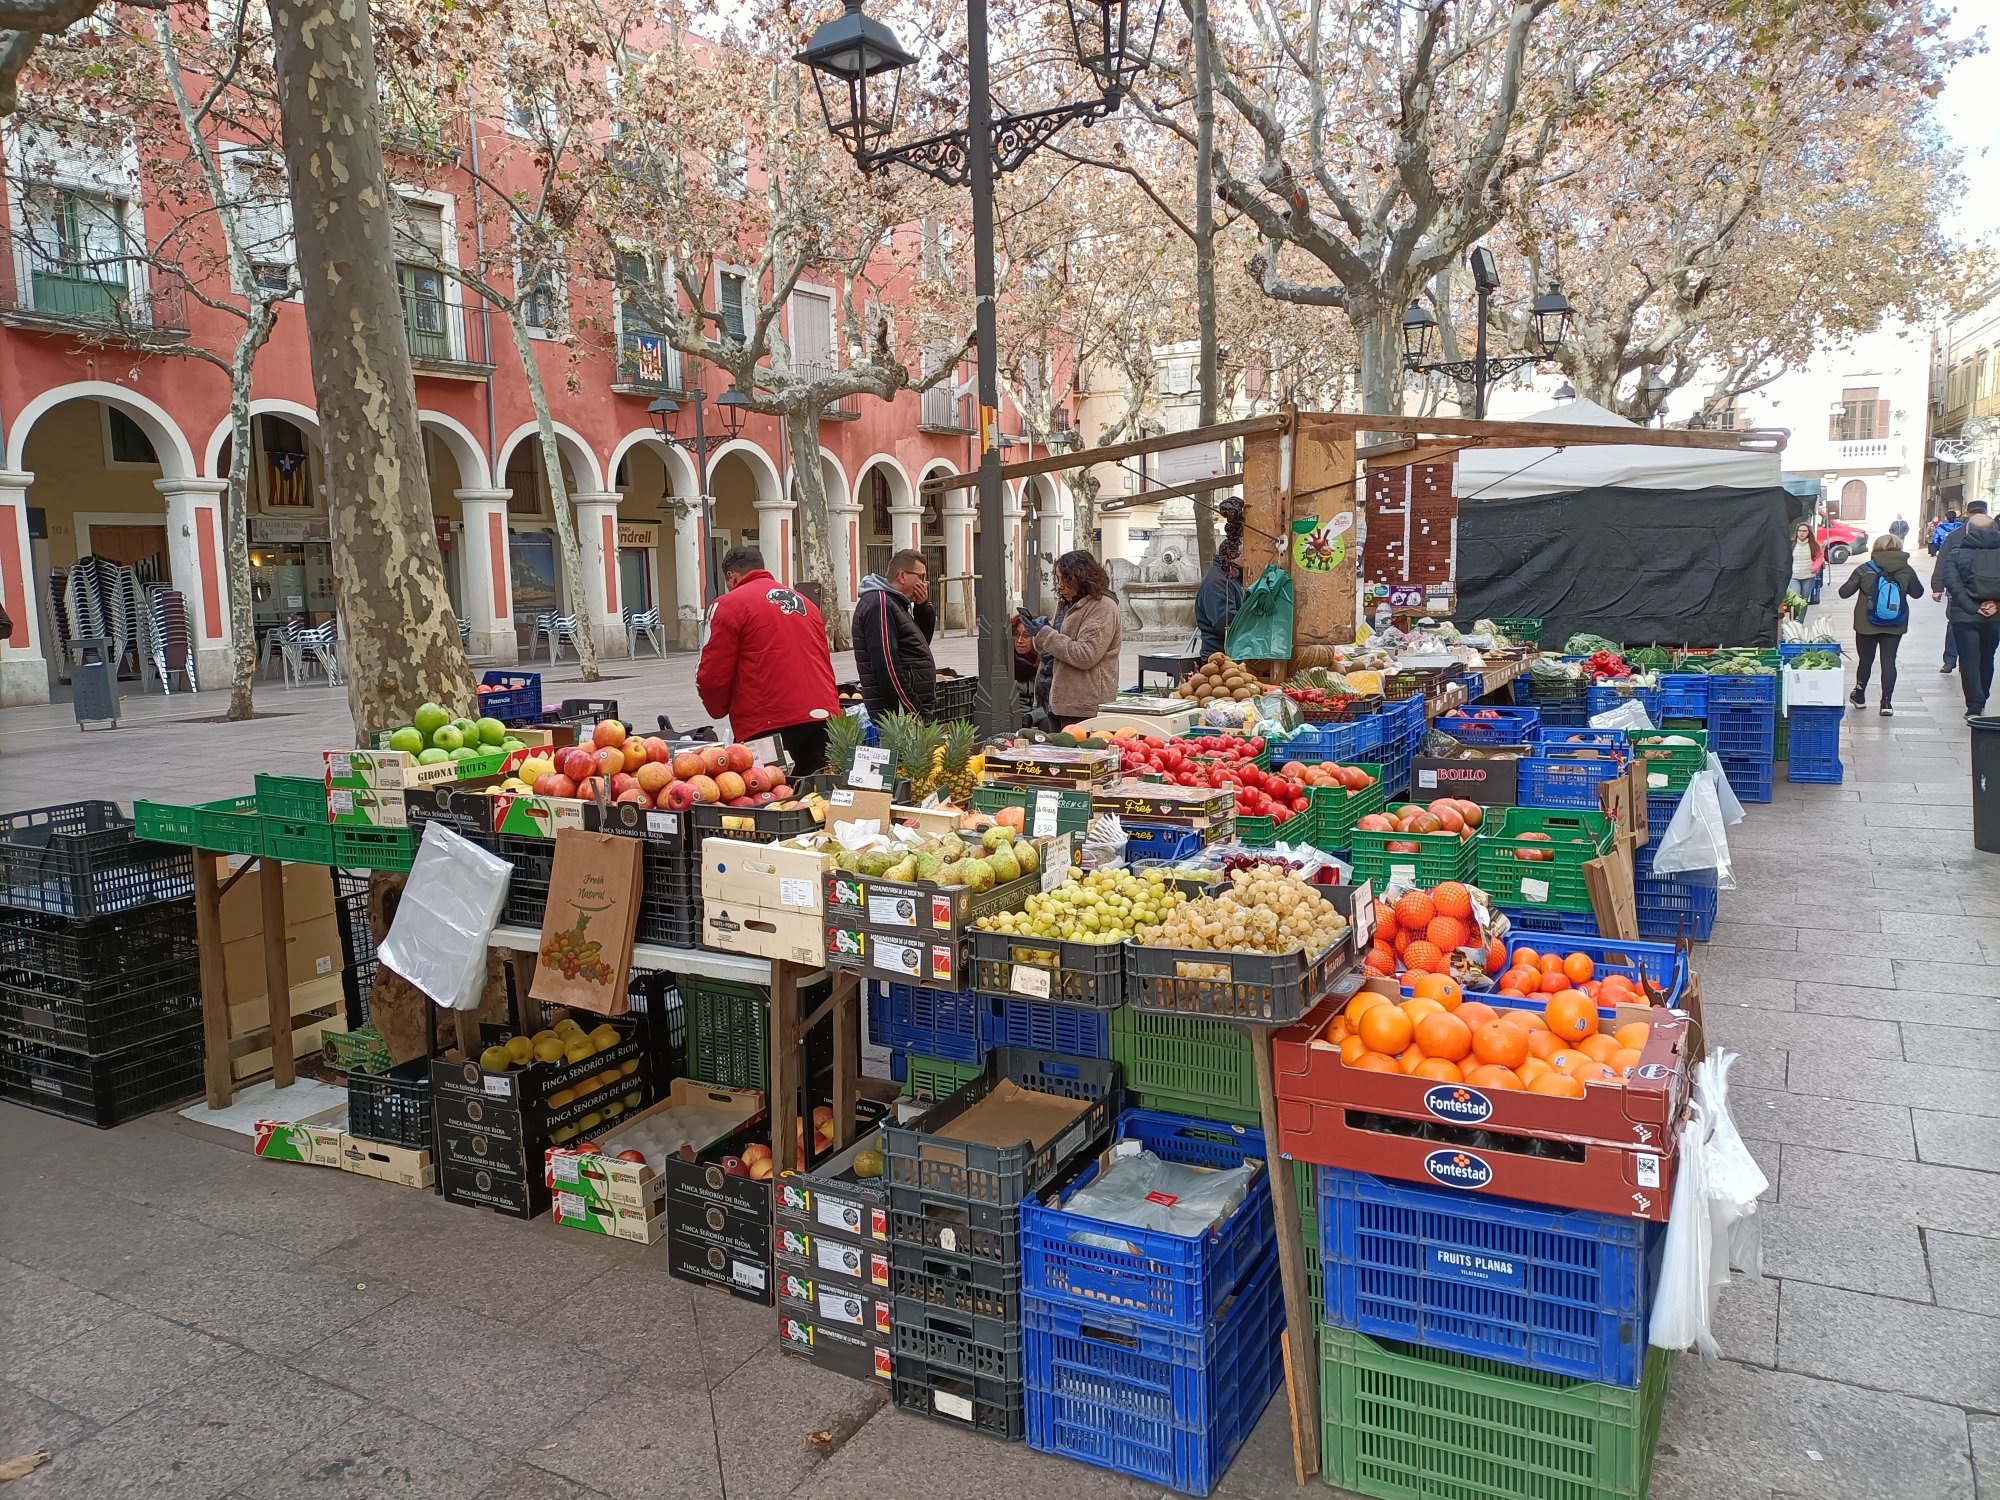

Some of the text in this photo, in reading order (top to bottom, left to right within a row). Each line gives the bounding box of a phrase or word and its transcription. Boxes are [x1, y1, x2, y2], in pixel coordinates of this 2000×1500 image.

[619, 530, 652, 544] ndrell
[417, 761, 487, 782] GIRONA FRUITS
[1015, 760, 1042, 775] Fres
[1437, 768, 1487, 781] BOLLO
[1125, 799, 1152, 814] Fres
[648, 831, 664, 839] RIOJA
[583, 874, 605, 885] Fresh
[577, 888, 606, 900] Natural
[971, 905, 990, 920] PERAS
[990, 900, 998, 913] DE
[542, 1042, 639, 1091] FINCA SEÑORÍO DE RIOJA
[546, 1076, 642, 1128] FINCA SEÑORÍO DE RIOJA
[1429, 1095, 1487, 1116] Fontestad
[1430, 1160, 1487, 1181] Fontestad
[681, 1182, 699, 1193] FINCA
[733, 1197, 750, 1208] RIOJA
[681, 1223, 699, 1234] FINCA
[725, 1236, 733, 1244] DE
[734, 1238, 751, 1249] RIOJA
[683, 1261, 700, 1273] FINCA
[1437, 1250, 1513, 1275] FRUITS PLANAS
[1461, 1269, 1489, 1279] VILAFRANCA
